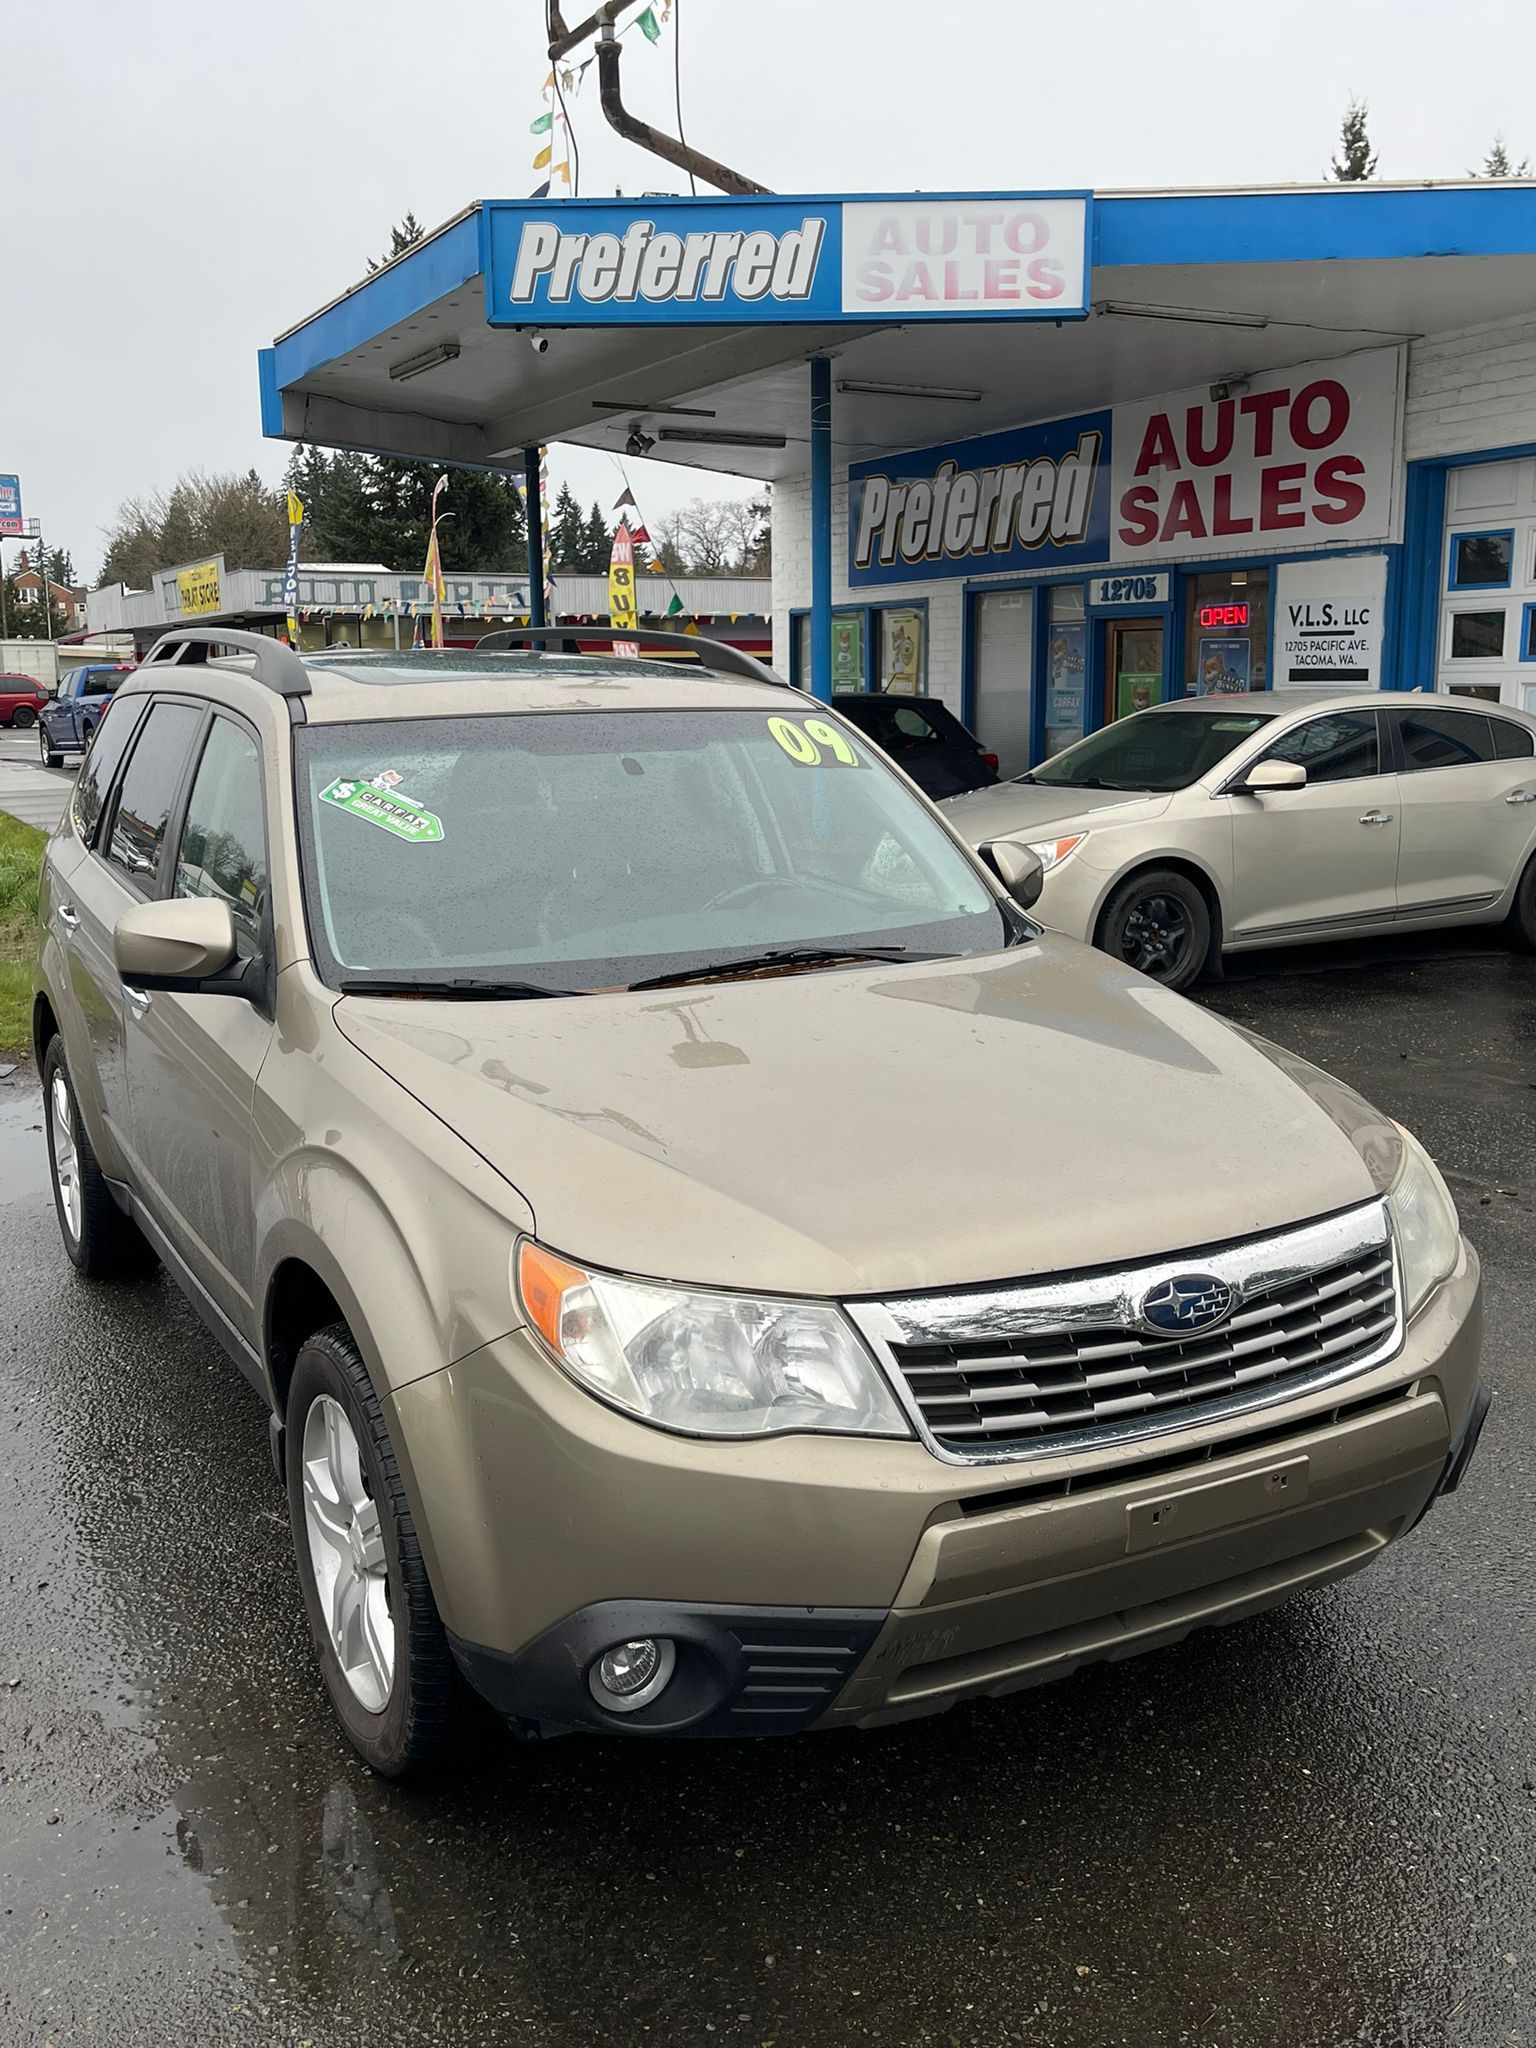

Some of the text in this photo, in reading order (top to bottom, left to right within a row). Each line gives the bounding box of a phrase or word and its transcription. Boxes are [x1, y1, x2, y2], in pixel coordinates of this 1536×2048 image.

[867, 212, 1051, 256] AUTO
[510, 218, 828, 303] Preferred
[855, 259, 1066, 302] SALES
[1133, 379, 1351, 477] AUTO
[854, 430, 1103, 570] Preferred
[1117, 455, 1366, 547] SALES
[1101, 577, 1157, 602] 12705
[1200, 606, 1247, 626] OPEN
[1288, 603, 1370, 627] V.L.S. LLC
[1285, 639, 1370, 652] 12705 PACIFIC AVE.
[1295, 655, 1358, 668] TACOMA, WA.
[766, 716, 859, 767] 09
[351, 799, 387, 819] GREAT
[386, 812, 420, 836] VALUE
[360, 791, 432, 830] CARFAX
